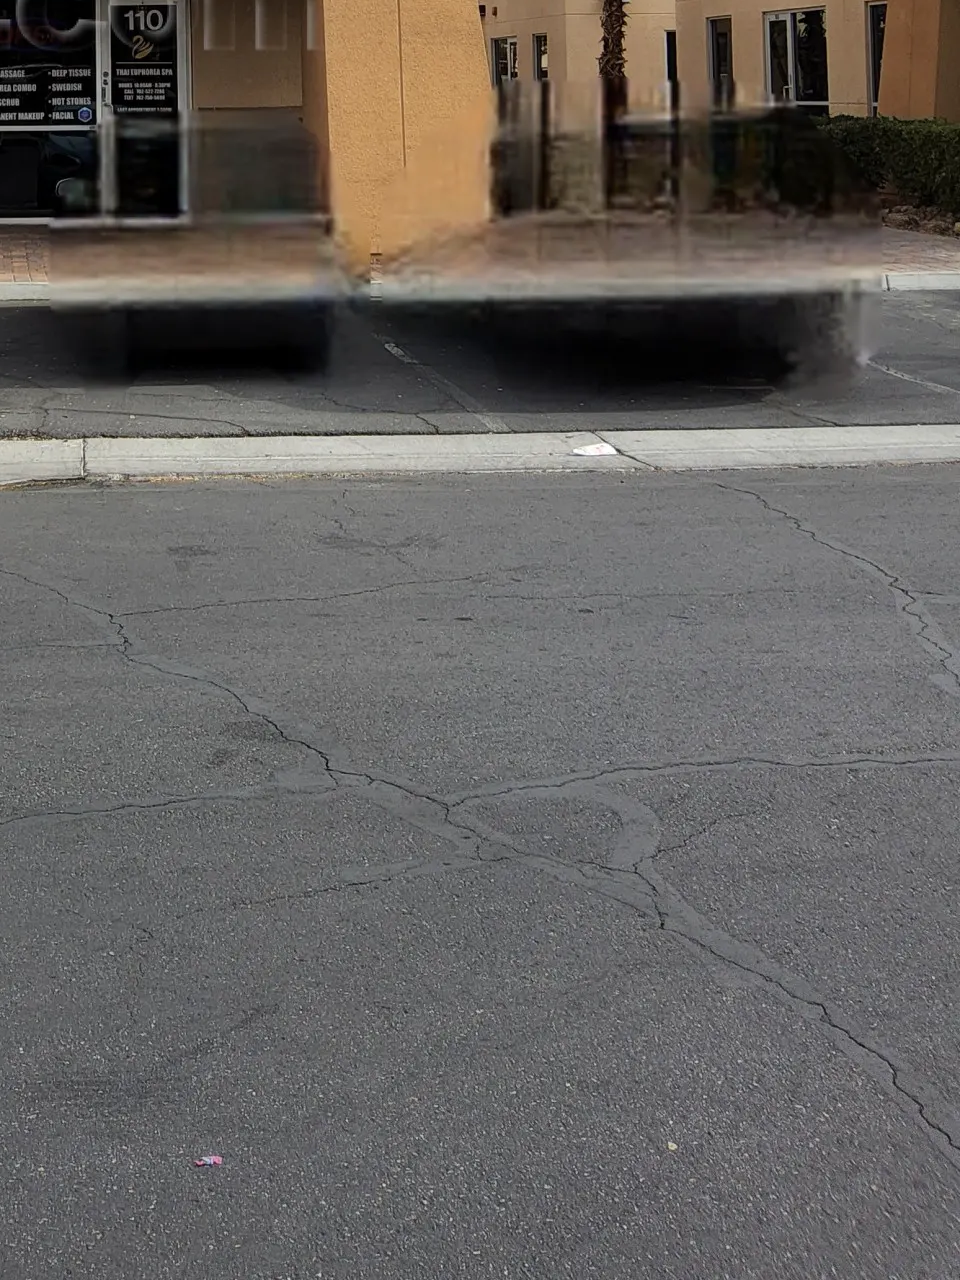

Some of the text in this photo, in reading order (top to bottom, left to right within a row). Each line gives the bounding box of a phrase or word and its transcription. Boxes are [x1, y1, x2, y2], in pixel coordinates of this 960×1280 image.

[124, 9, 163, 31] 110
[52, 69, 91, 77] DEEP TISSUE
[12, 84, 37, 92] COMBO
[52, 83, 82, 91] SWEDISH
[66, 97, 91, 105] STONES
[18, 112, 45, 120] MAKEUP
